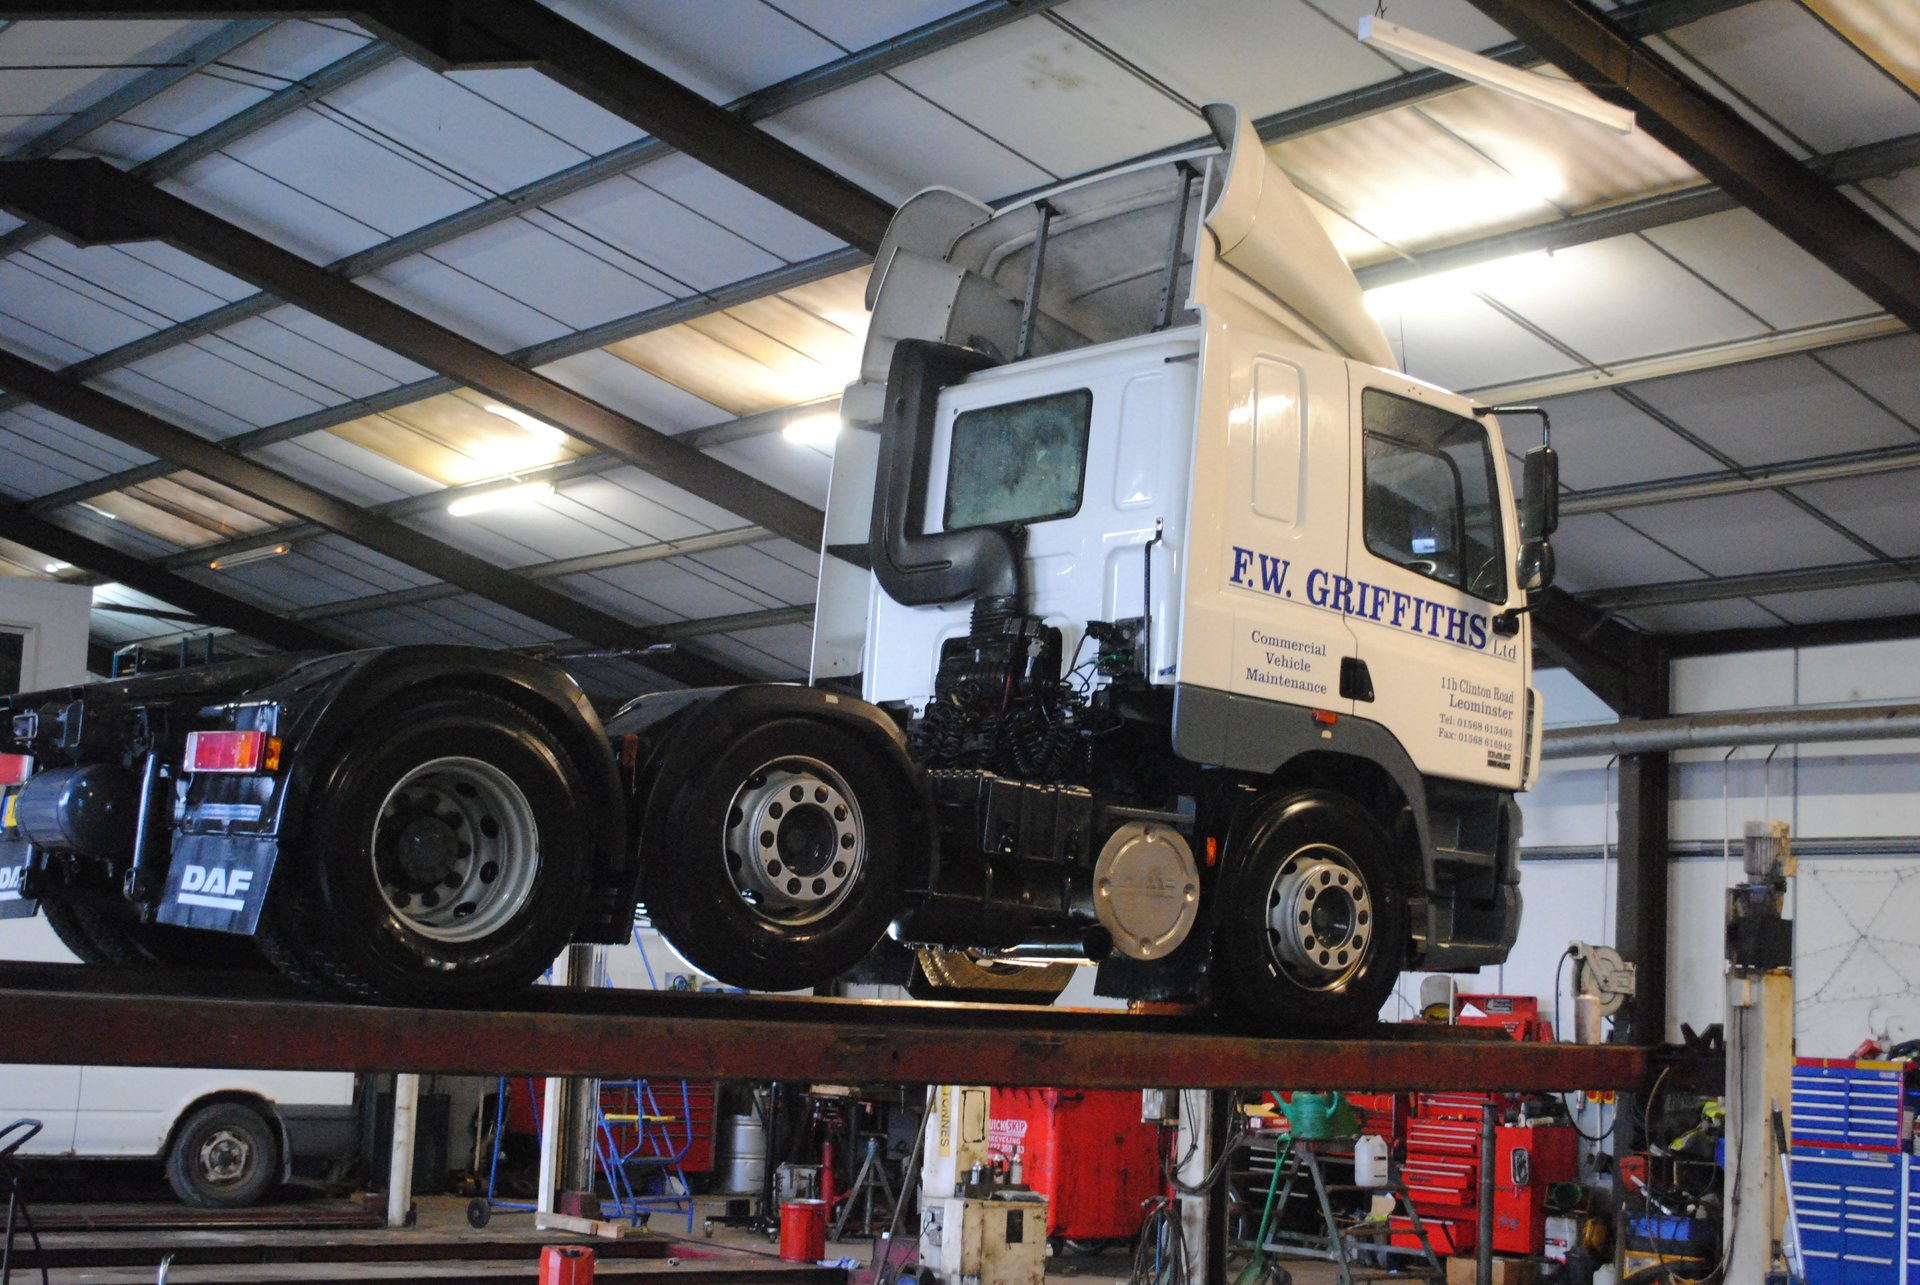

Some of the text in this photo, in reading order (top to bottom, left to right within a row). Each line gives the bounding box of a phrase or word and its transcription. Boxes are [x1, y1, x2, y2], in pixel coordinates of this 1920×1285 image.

[1230, 546, 1517, 660] F.W. GRIFFITHS Ltd
[1251, 630, 1326, 656] Commercial
[1266, 652, 1311, 672] Vehicle
[1246, 667, 1327, 694] Maintenance
[1441, 677, 1514, 704] 11b Clinton Road
[1449, 694, 1513, 720] Leominster
[1439, 713, 1456, 726] Tel:
[1457, 718, 1483, 732] 01568
[1458, 733, 1483, 746] 01568
[1487, 750, 1511, 761] DAF
[0, 866, 21, 889] DA
[181, 865, 254, 896] DAF
[988, 1119, 1026, 1133] UICK SKIP
